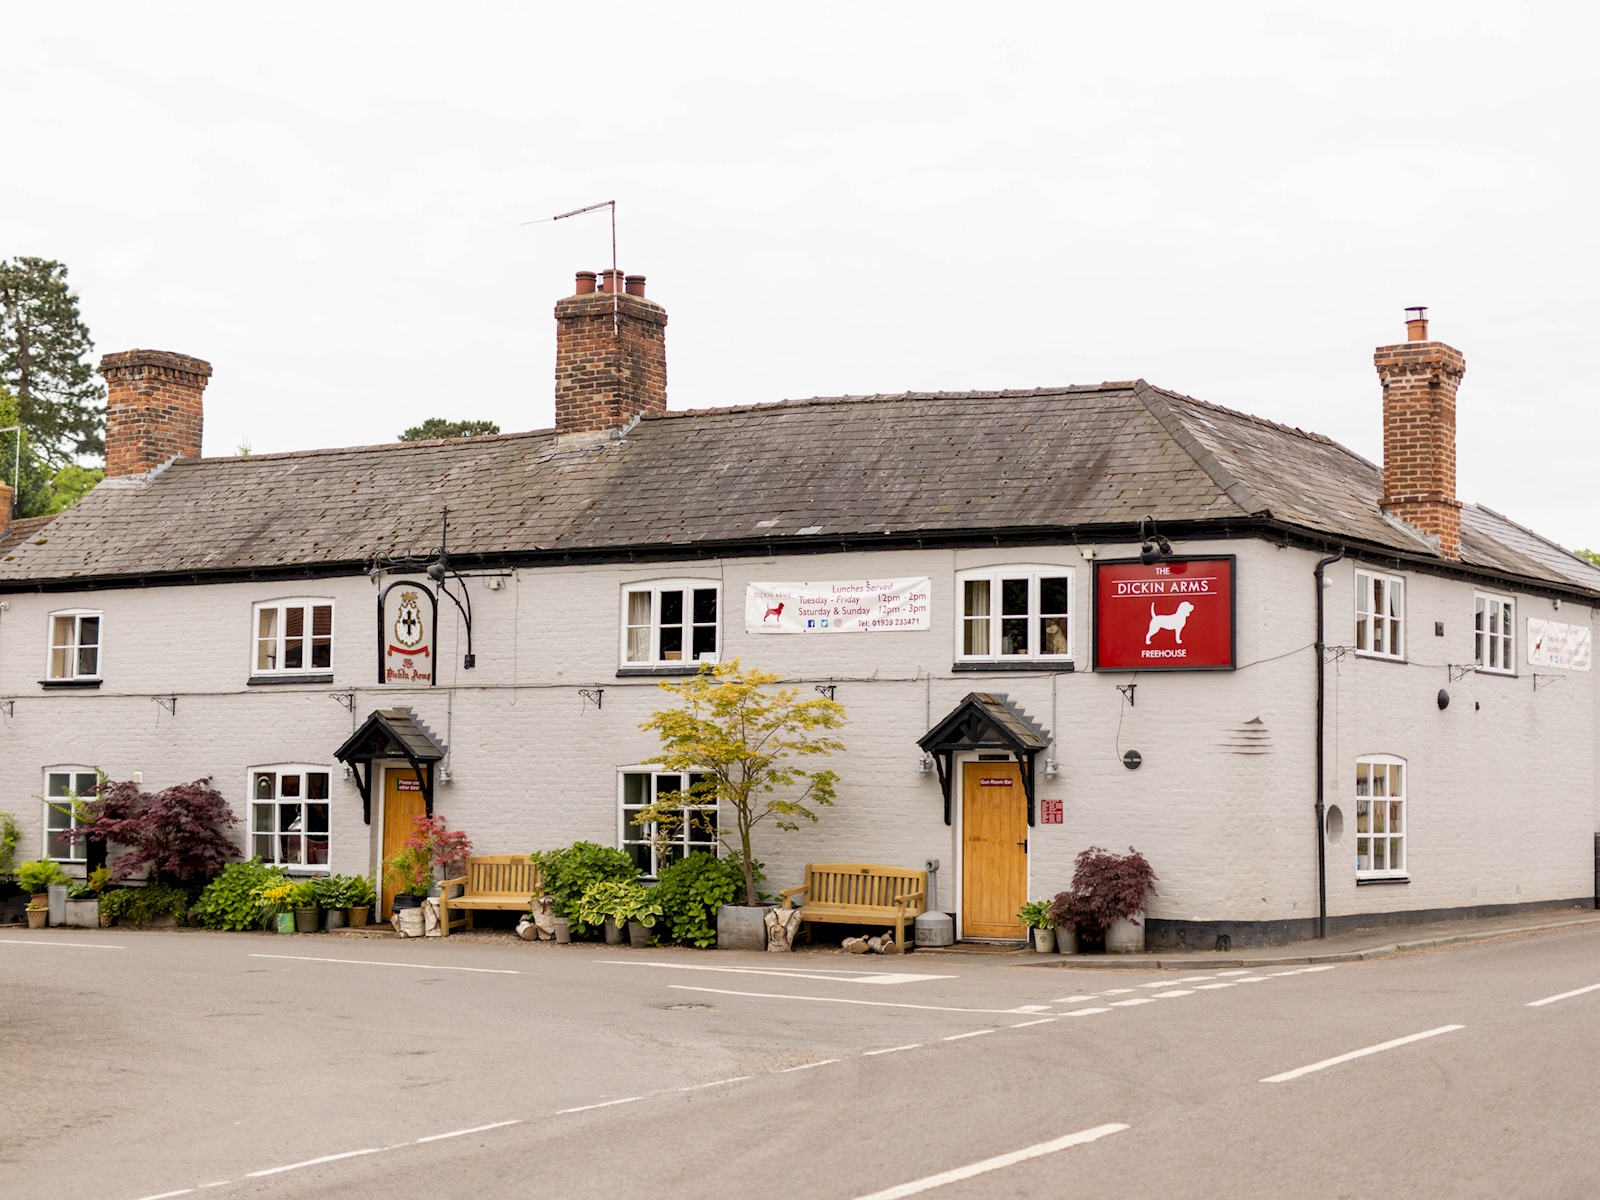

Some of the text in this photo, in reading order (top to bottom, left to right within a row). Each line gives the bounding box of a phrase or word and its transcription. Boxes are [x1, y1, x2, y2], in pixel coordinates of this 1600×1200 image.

[1155, 567, 1171, 575] THE
[832, 582, 894, 594] Lunches Served
[1117, 580, 1209, 595] DICKIN ARMS
[799, 595, 828, 606] Tuesday
[836, 595, 860, 605] Friday
[878, 593, 901, 604] 12pm
[908, 592, 927, 602] 2pm
[798, 607, 831, 617] Saturday
[833, 606, 840, 615] &
[842, 606, 871, 616] Sunday
[878, 605, 901, 615] 12pm
[908, 603, 927, 614] 3pm
[872, 619, 893, 627] 01939
[895, 618, 920, 626] 233471
[1141, 649, 1187, 658] FREEHOUSE
[411, 669, 431, 681] Arms
